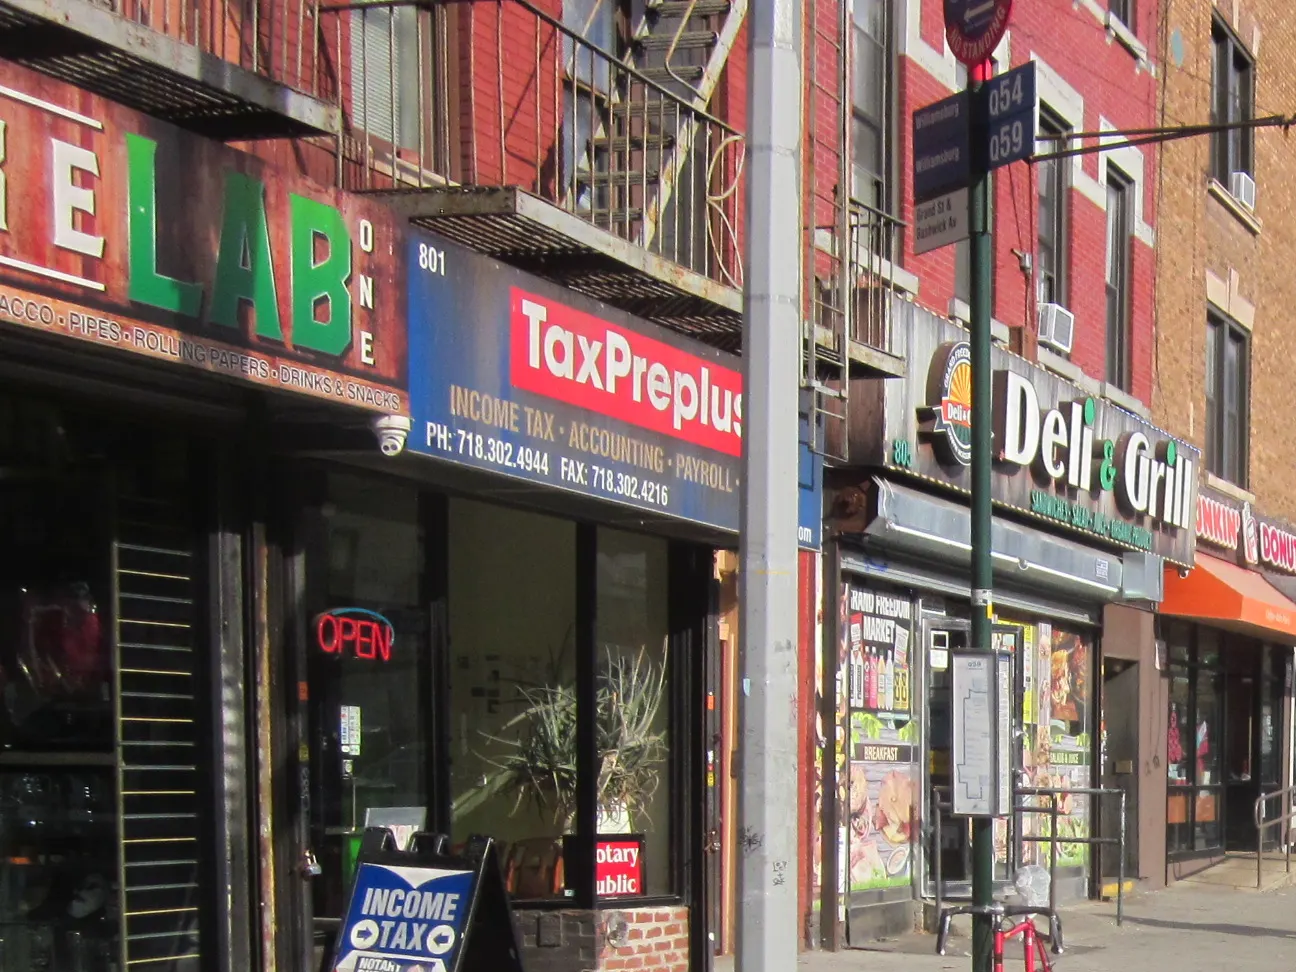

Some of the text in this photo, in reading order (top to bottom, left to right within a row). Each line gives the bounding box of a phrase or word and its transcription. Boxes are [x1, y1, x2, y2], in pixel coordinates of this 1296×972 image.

[961, 5, 1006, 60] STANDING
[989, 73, 1023, 116] Q54
[989, 120, 1023, 161] Q59
[126, 132, 353, 358] LAB
[419, 243, 446, 276] 801
[68, 311, 122, 343] PIPES
[133, 327, 207, 363] ROLLING
[209, 348, 270, 380] PAPERS
[279, 364, 333, 395] DRINKS
[335, 380, 344, 398] &
[348, 383, 400, 411] SNACKS
[947, 402, 962, 422] Deli
[450, 384, 733, 493] INCOME TAX ACCOUNTING PAYROLL
[1003, 370, 1192, 530] Deli & Grill
[426, 421, 669, 506] PH: 718.302.4944 FAX: 718.302.4216
[317, 612, 393, 662] OPEN
[863, 615, 895, 644] MARKET
[864, 746, 899, 761] BREAKFAST
[596, 843, 639, 868] otary
[361, 887, 461, 921] INCOME
[596, 874, 637, 895] ublic
[379, 920, 429, 951] TAX
